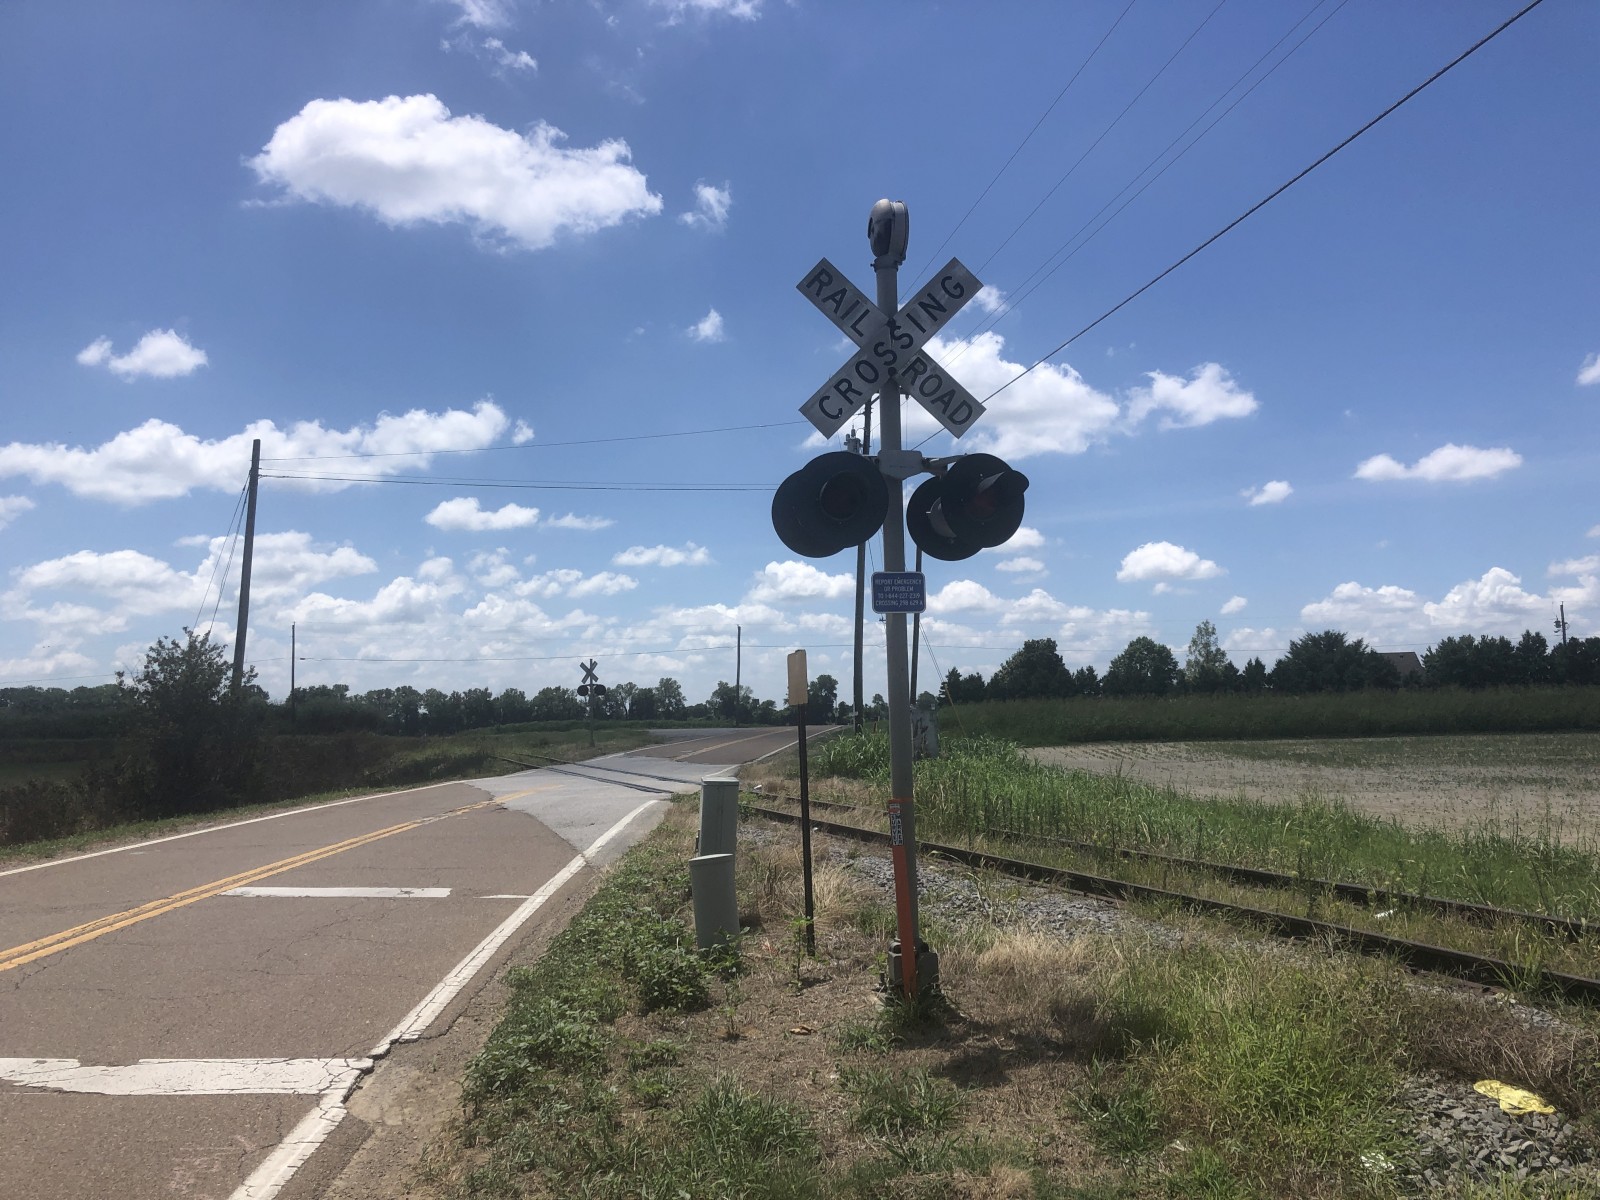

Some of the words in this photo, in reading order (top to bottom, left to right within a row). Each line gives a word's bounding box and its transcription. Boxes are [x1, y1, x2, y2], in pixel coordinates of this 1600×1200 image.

[806, 268, 870, 338] RAIL
[901, 356, 973, 426] ROAD
[818, 275, 965, 420] CROSSING
